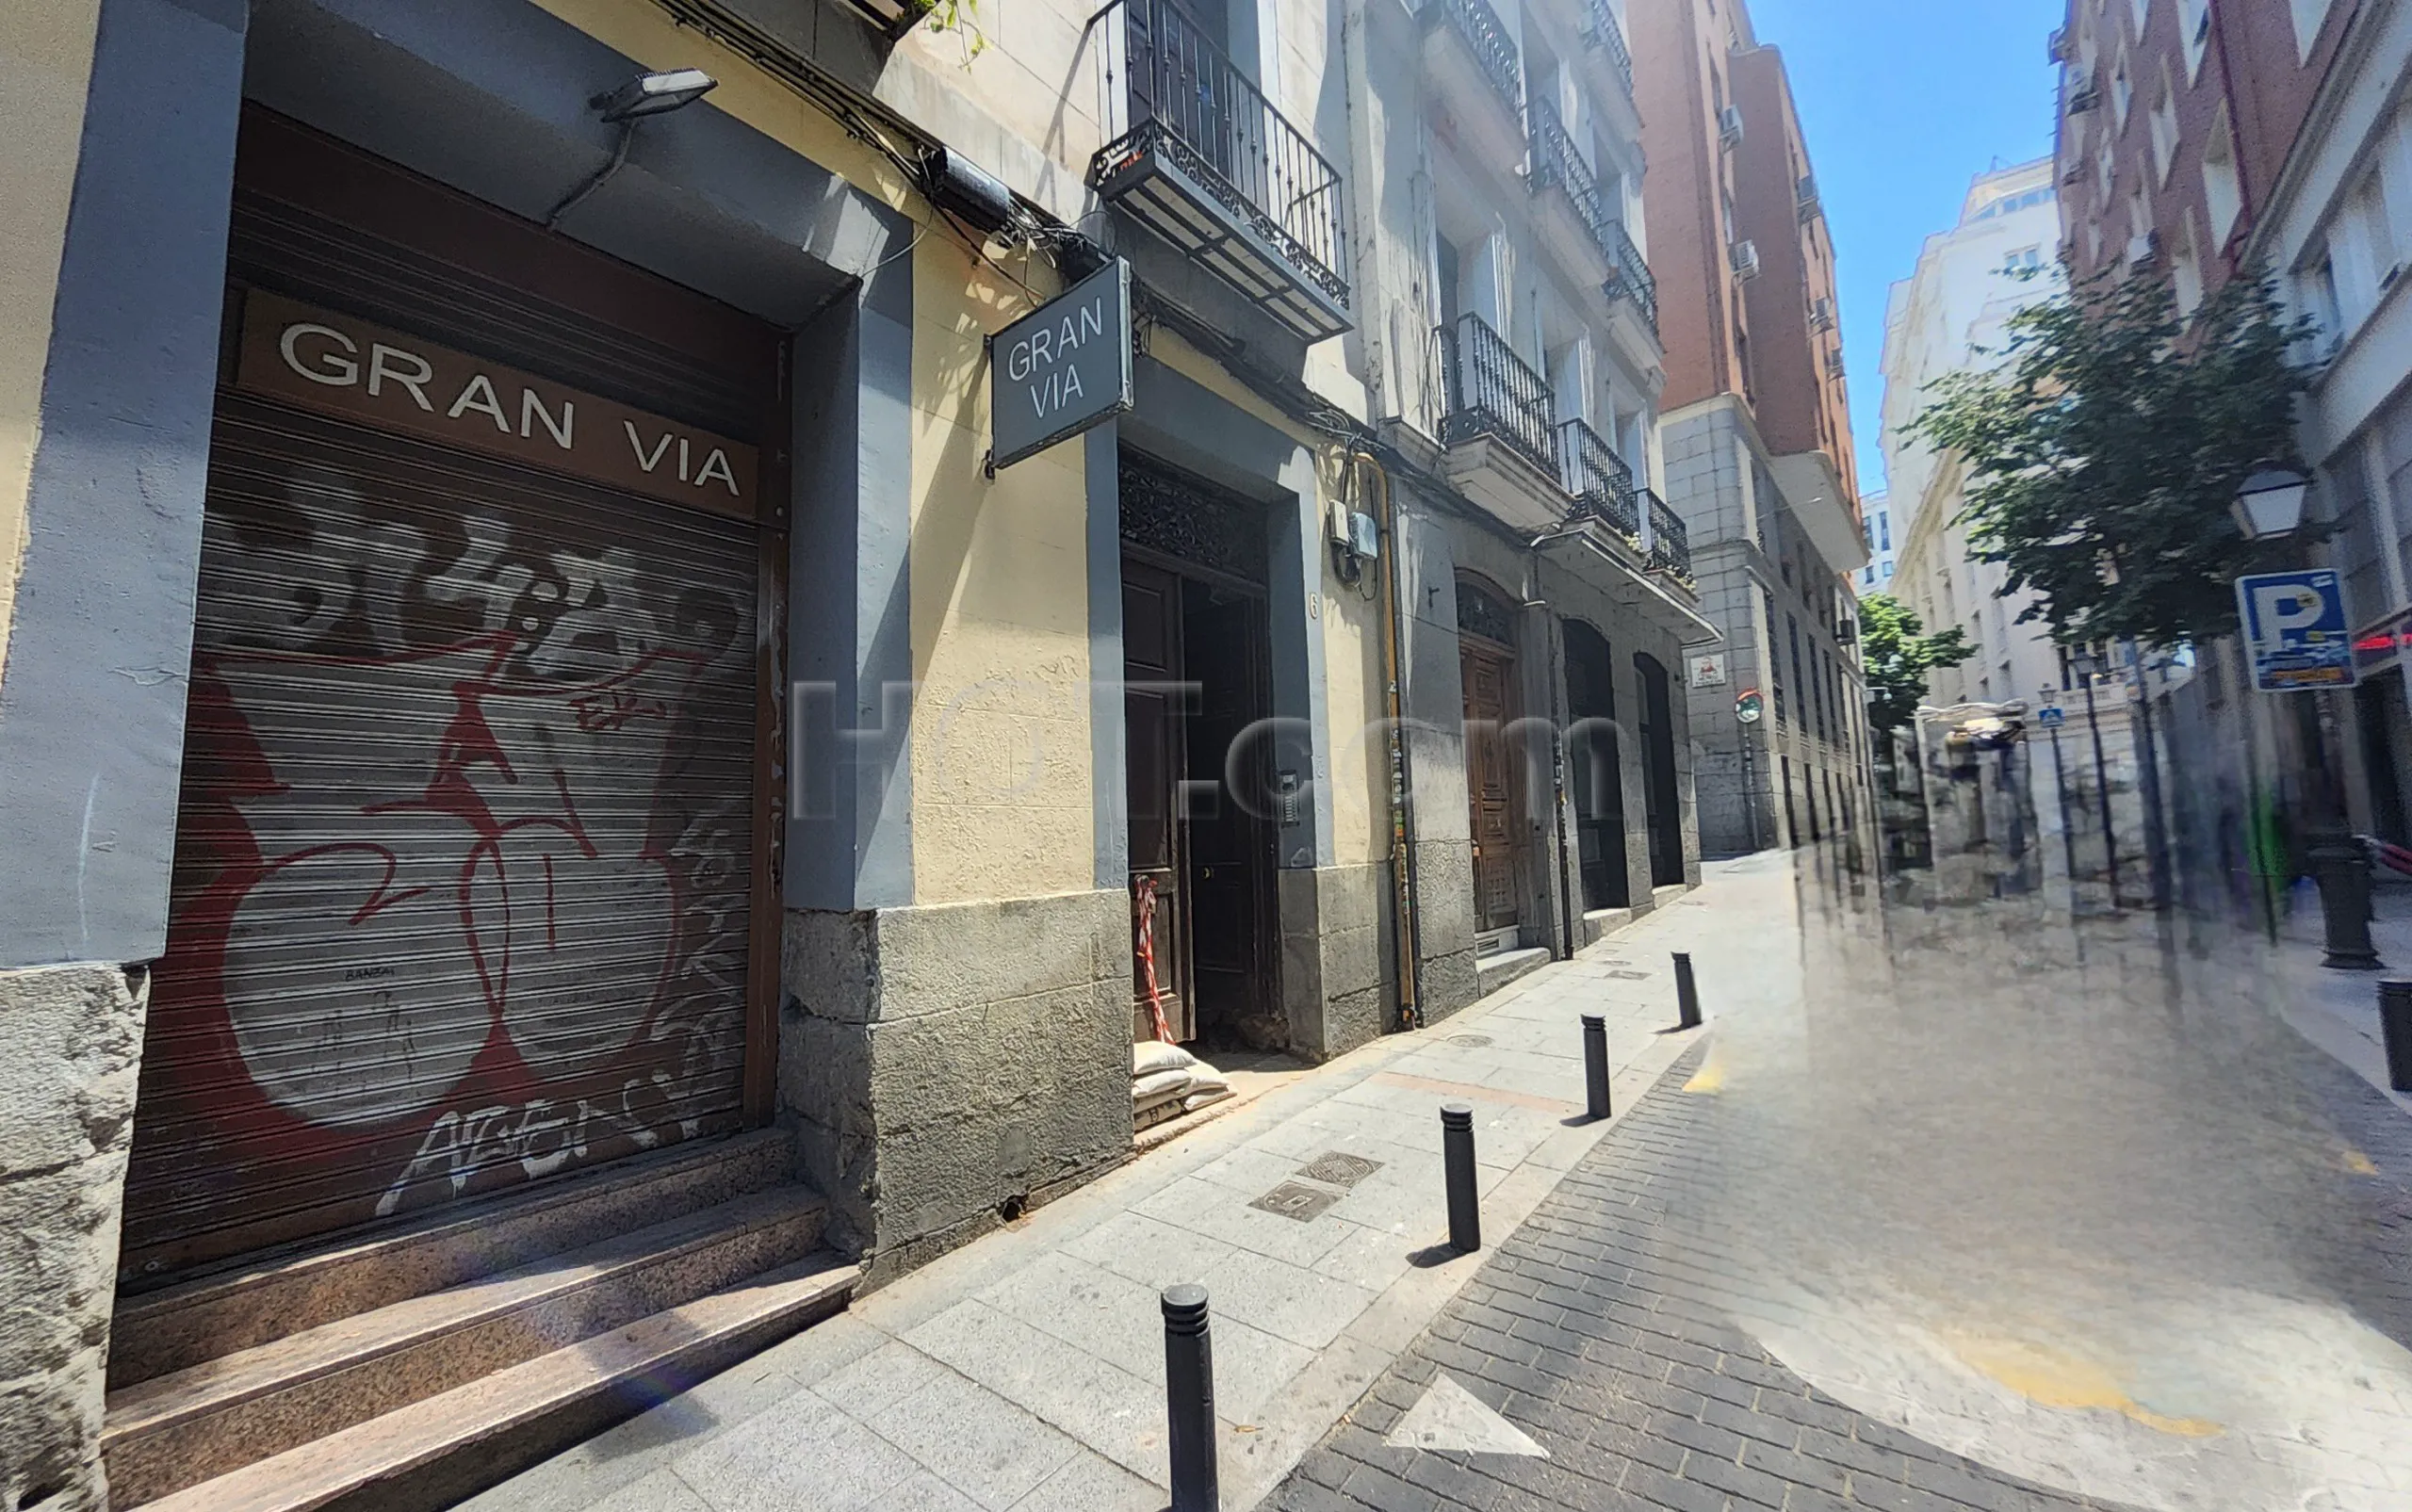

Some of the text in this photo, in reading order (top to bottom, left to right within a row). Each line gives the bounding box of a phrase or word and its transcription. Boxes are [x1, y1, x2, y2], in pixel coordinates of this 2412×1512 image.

[1008, 297, 1102, 382] GRAN
[279, 322, 742, 496] GRAN VIA
[1030, 365, 1084, 418] VIA
[1310, 592, 1318, 620] 6
[2253, 583, 2324, 653] P
